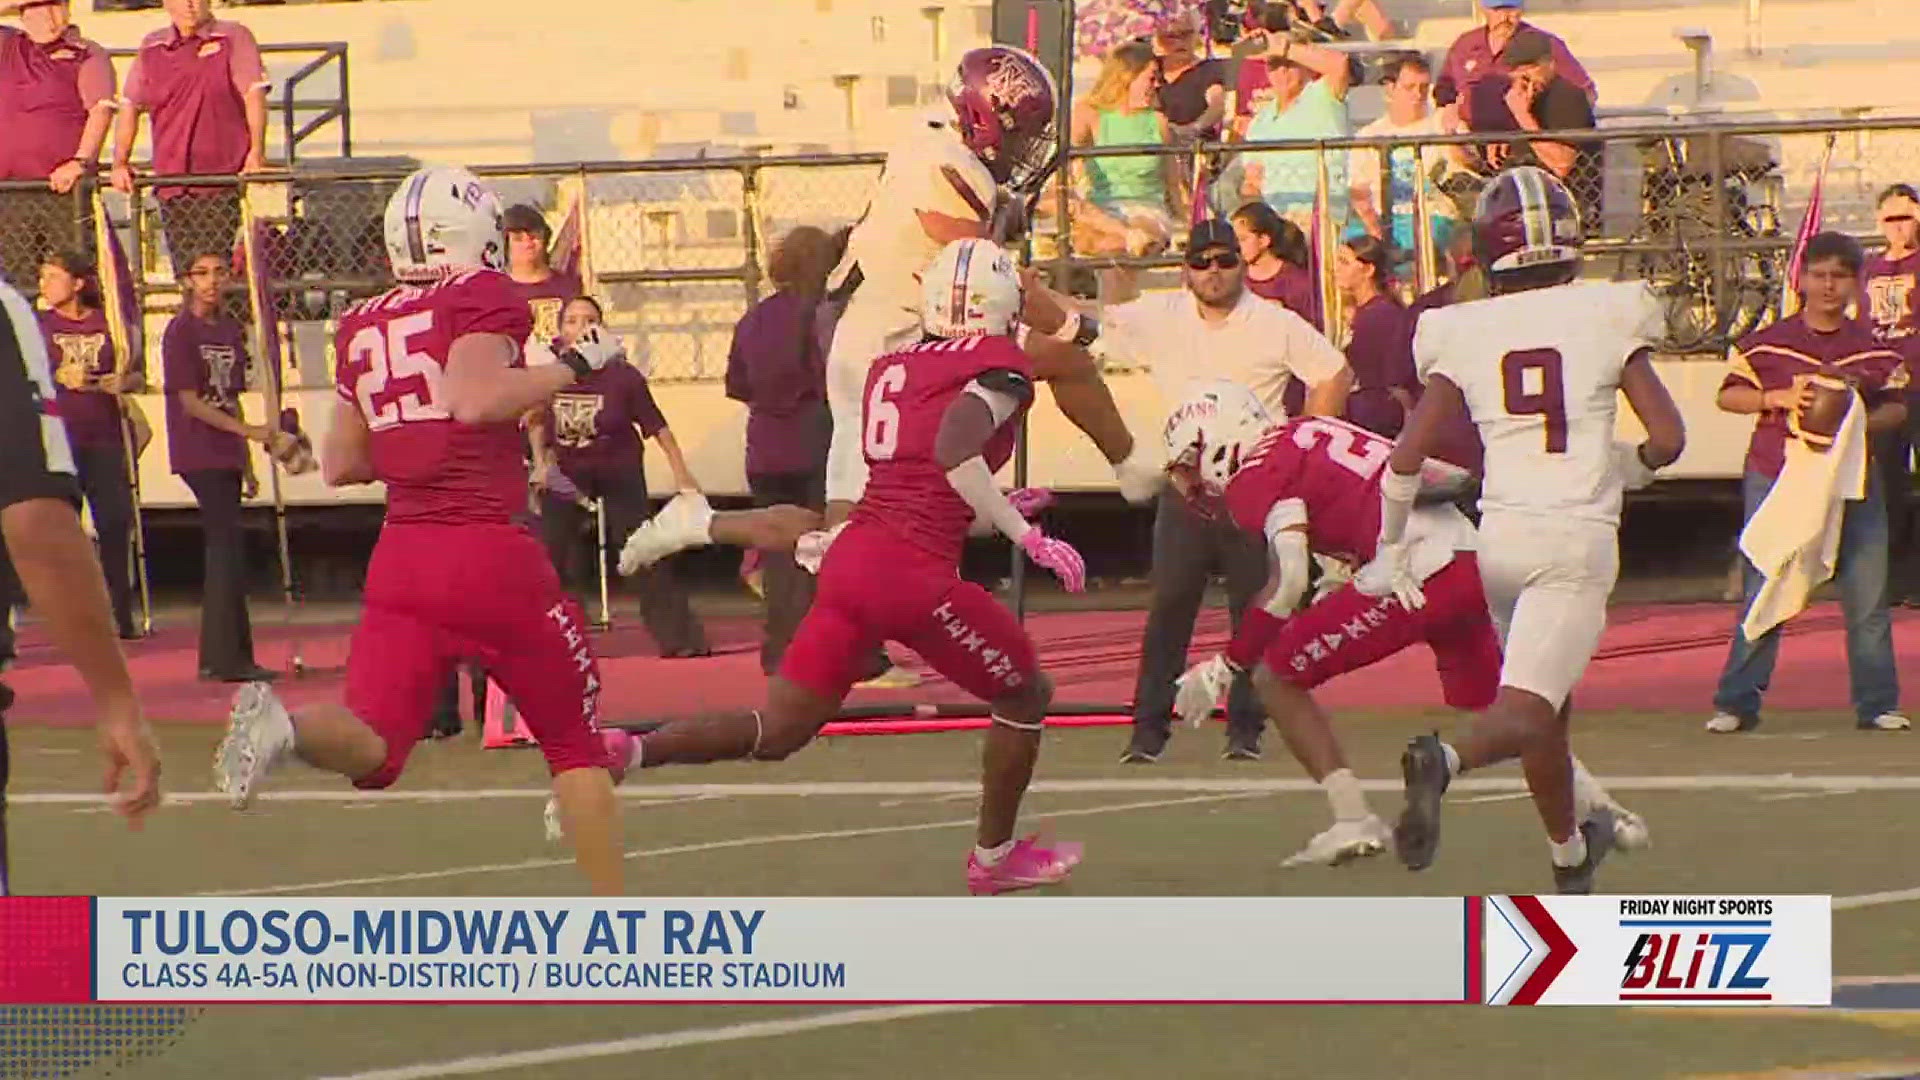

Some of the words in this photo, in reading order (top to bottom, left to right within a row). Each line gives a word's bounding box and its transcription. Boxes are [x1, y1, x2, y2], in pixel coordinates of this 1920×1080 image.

[348, 309, 453, 433] 25
[865, 363, 907, 460] 6
[1501, 347, 1568, 453] 9
[1292, 415, 1397, 480] 2
[932, 601, 1022, 687] TEXANS
